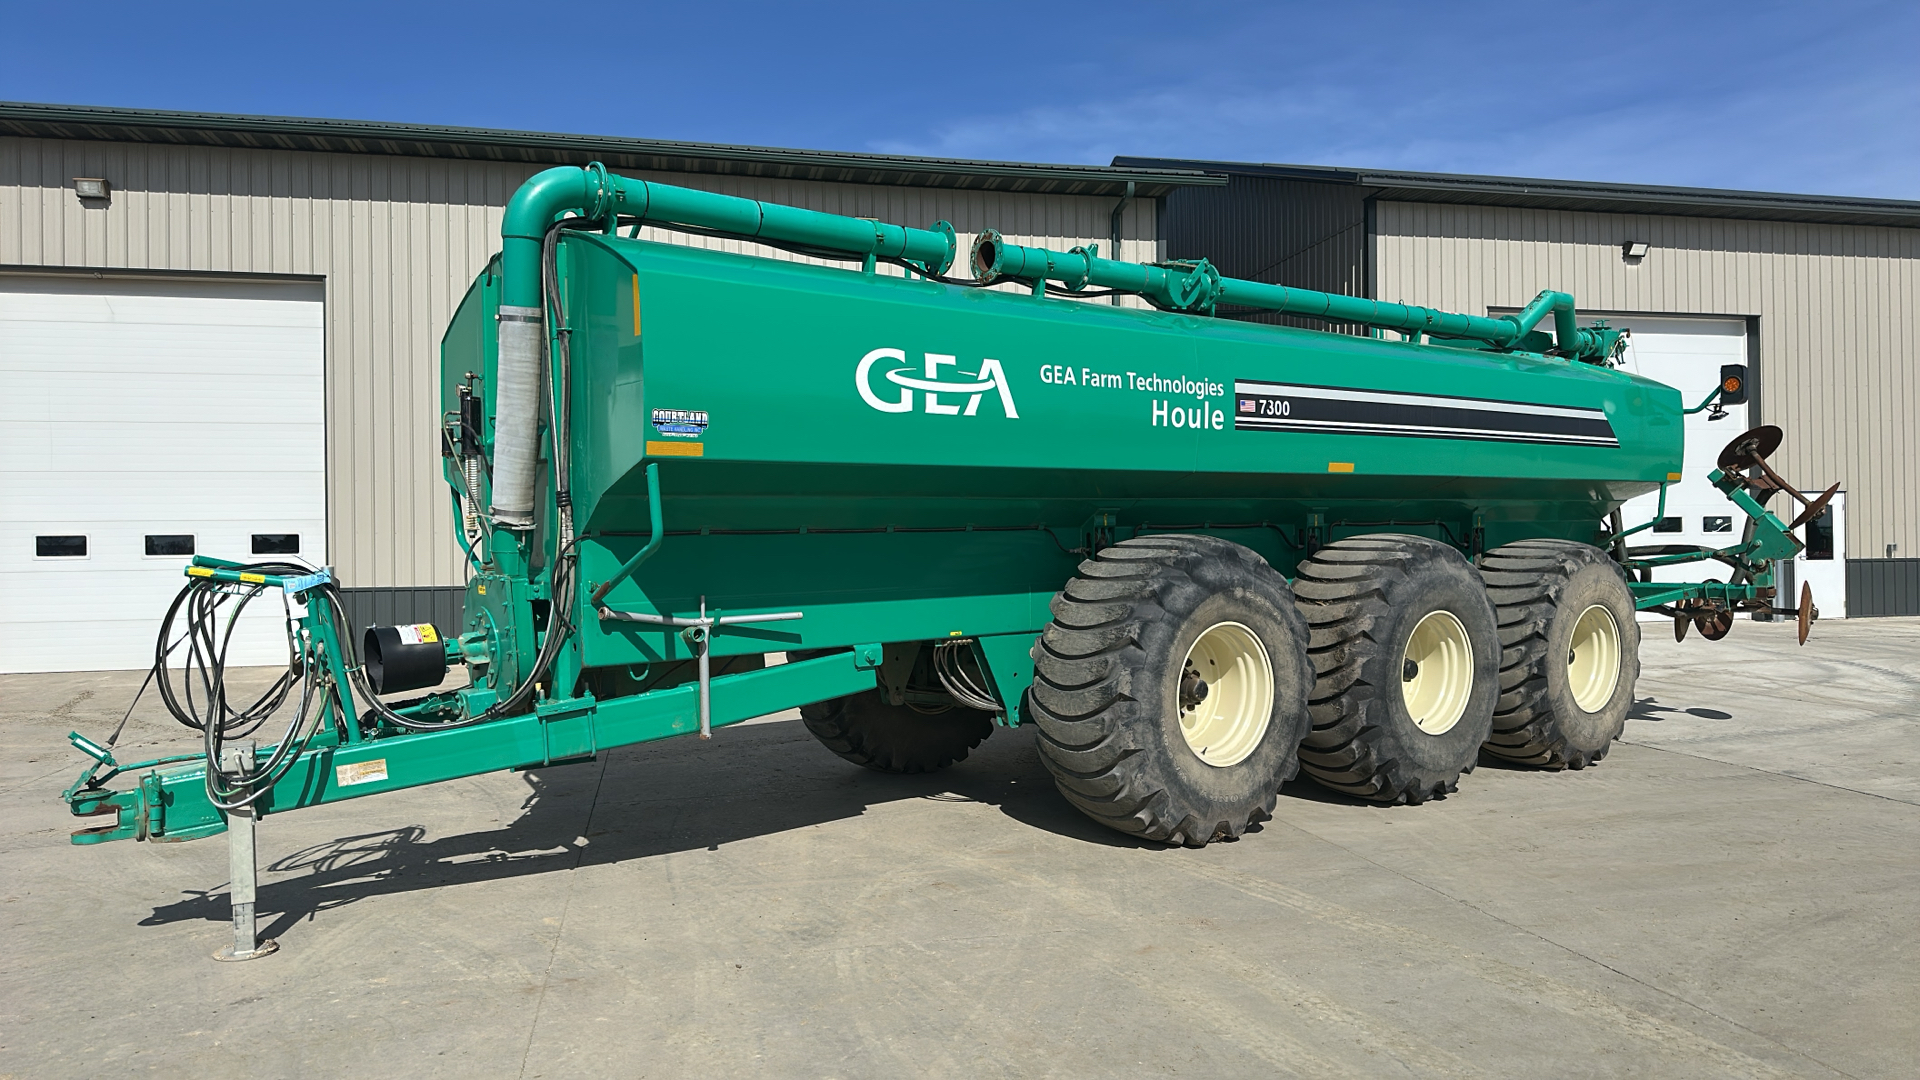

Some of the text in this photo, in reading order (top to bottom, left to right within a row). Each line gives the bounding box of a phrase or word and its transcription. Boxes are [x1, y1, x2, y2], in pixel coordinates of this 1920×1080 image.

[855, 347, 1020, 419] GEA
[1039, 364, 1225, 400] GEA Farm Technologies
[653, 410, 708, 424] COURTLAND
[1152, 399, 1225, 431] Houle
[1259, 399, 1290, 416] 7300
